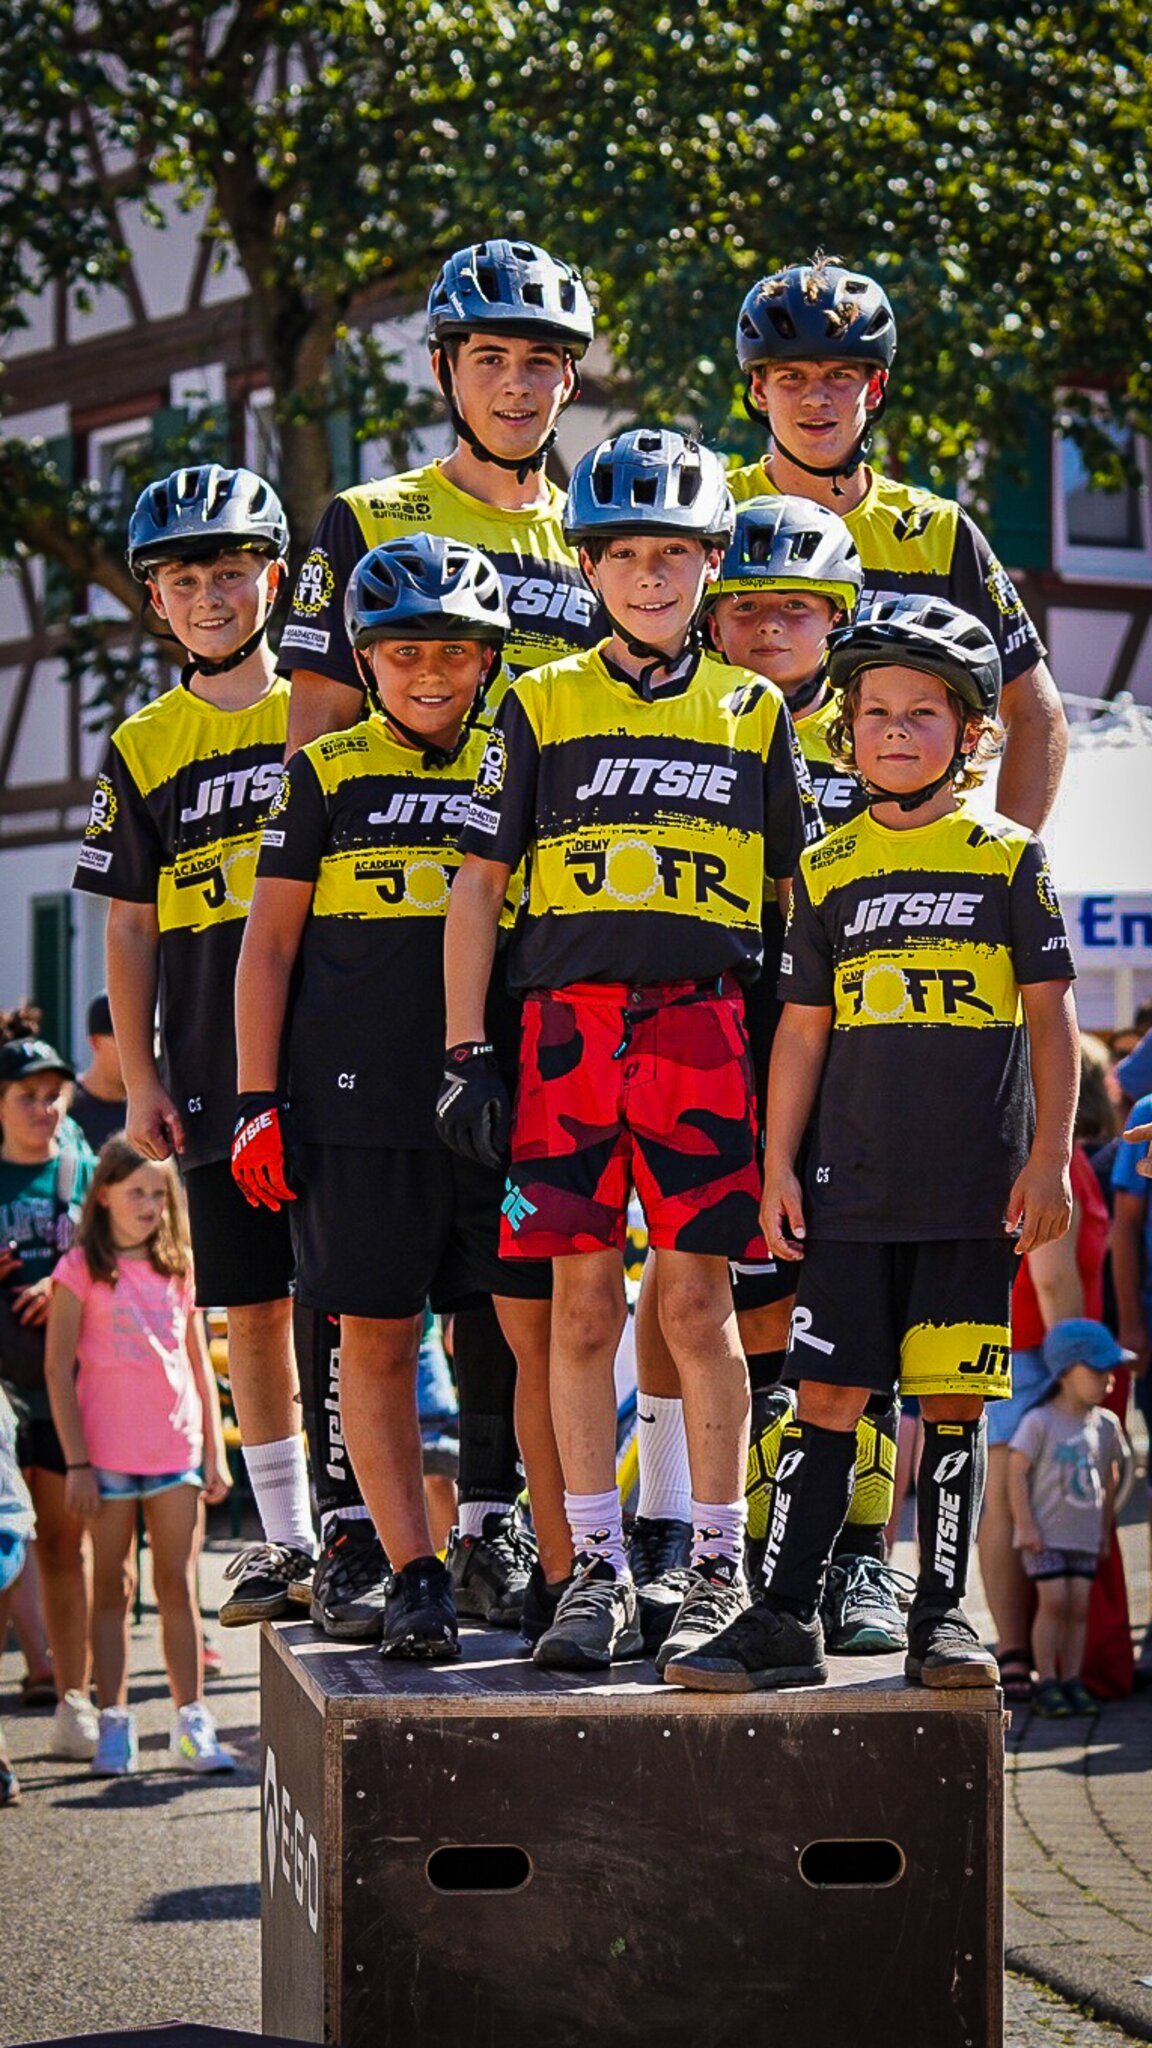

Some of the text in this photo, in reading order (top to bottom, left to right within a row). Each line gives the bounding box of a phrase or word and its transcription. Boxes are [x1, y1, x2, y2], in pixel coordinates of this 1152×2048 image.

[302, 562, 323, 583] JO
[173, 852, 222, 878] ACADEMY
[354, 859, 407, 871] ACADEMY
